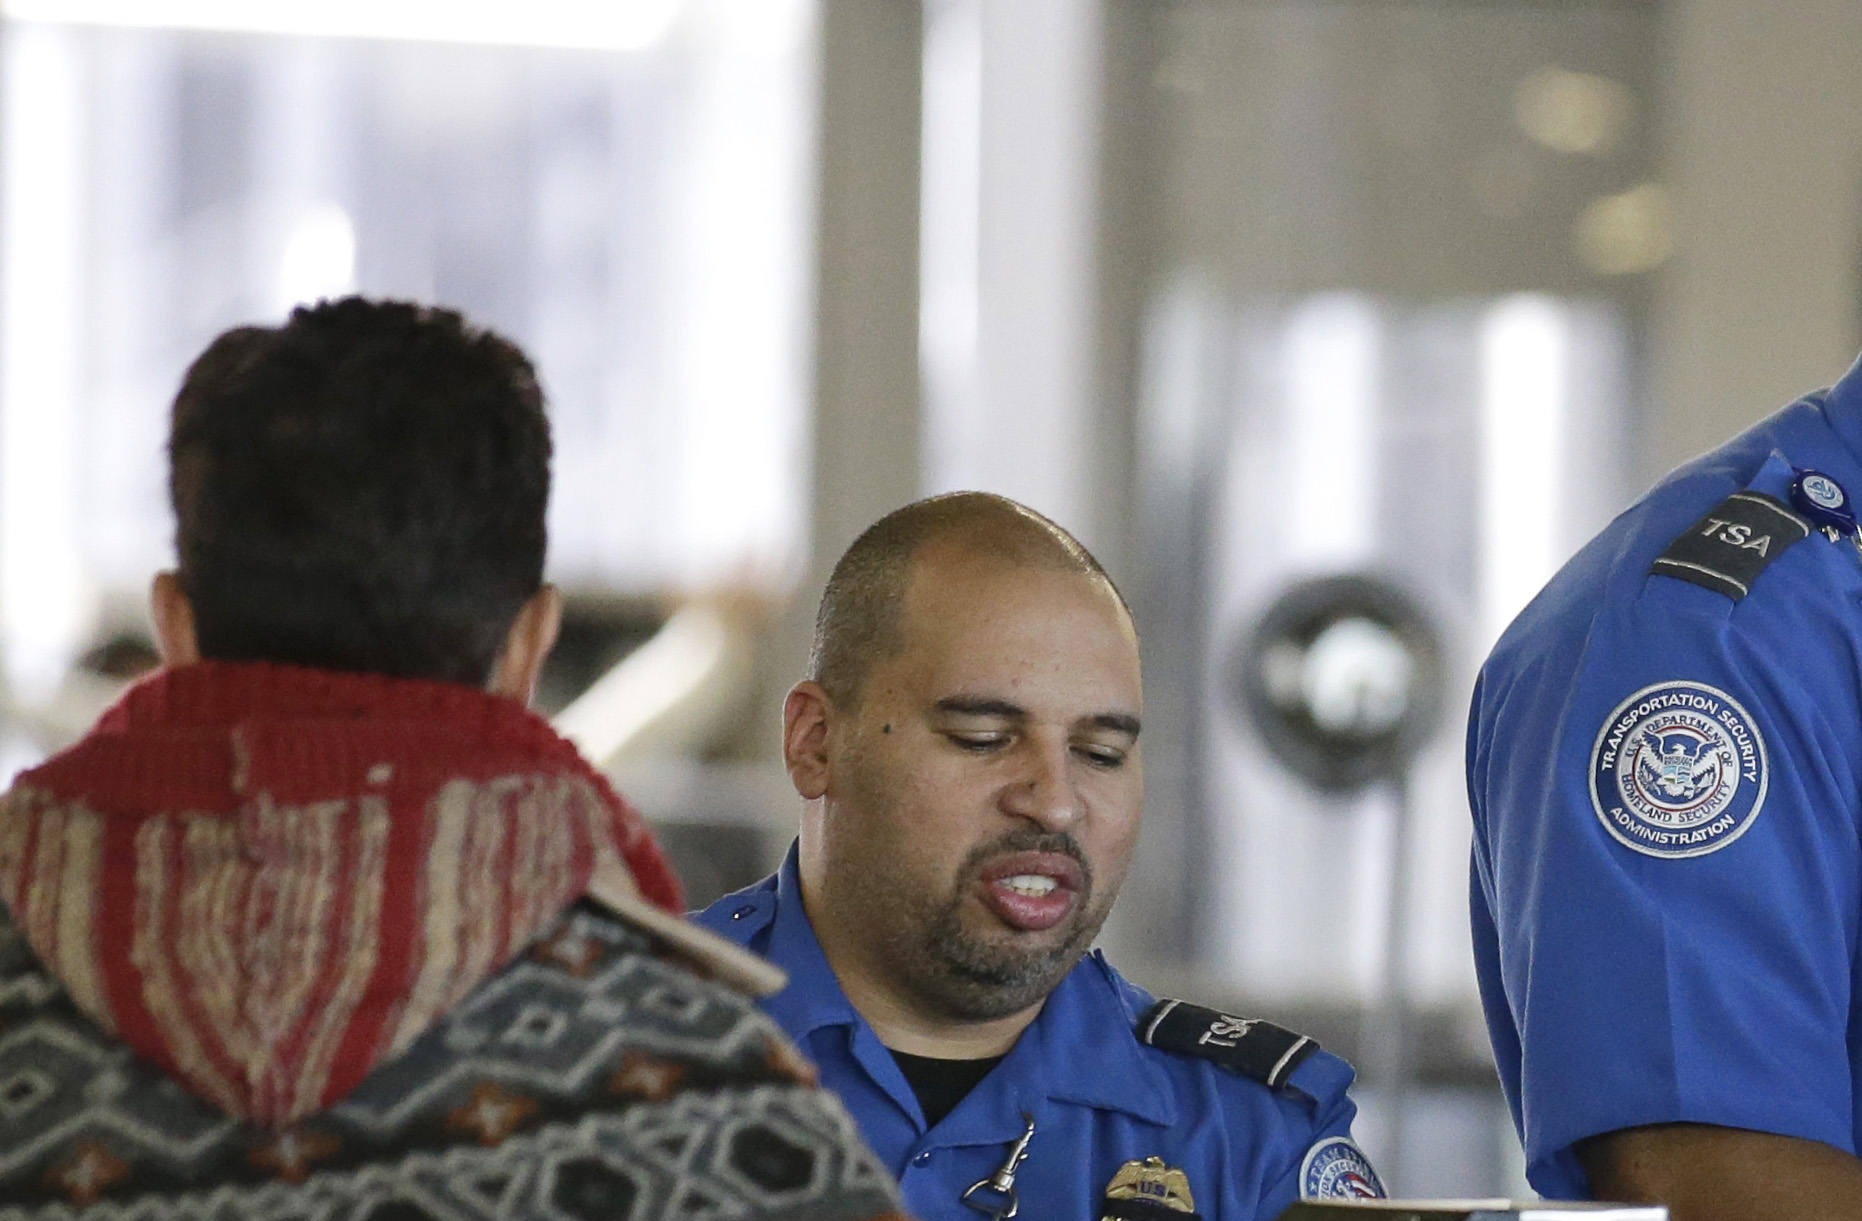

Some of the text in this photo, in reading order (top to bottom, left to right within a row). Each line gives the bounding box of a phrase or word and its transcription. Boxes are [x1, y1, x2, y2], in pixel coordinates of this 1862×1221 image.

[1701, 517, 1771, 558] TSA
[1602, 693, 1757, 783] TRANSPORTATION SECURITY
[1645, 714, 1727, 749] DEPARTMENT
[1720, 750, 1734, 768] OF
[1621, 773, 1731, 823] HOMELAND SECURITY
[1610, 806, 1736, 845] ADMINISTRATION
[1198, 1014, 1262, 1047] TSA
